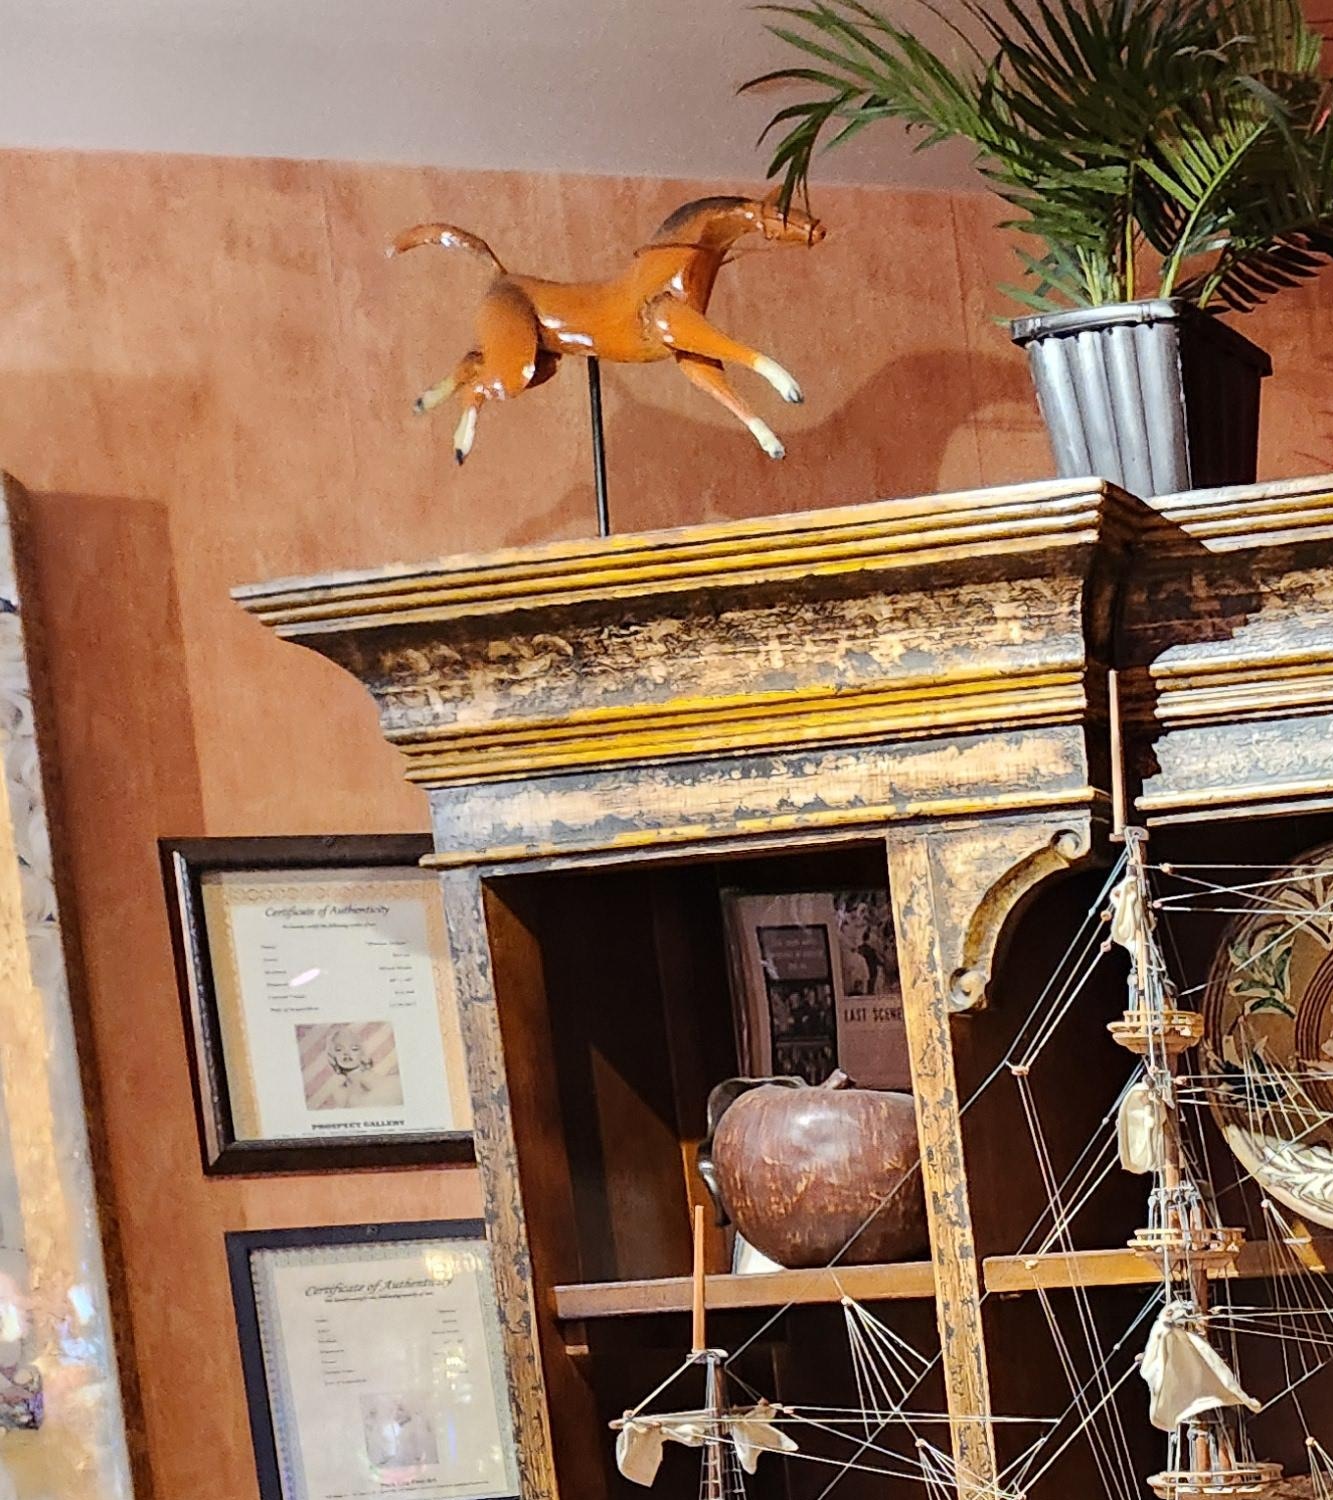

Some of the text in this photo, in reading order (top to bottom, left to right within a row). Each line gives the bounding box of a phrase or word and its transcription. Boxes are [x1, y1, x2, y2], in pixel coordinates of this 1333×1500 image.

[265, 906, 314, 919] Certificate
[318, 905, 328, 918] of
[844, 1008, 866, 1022] LAST
[305, 1282, 365, 1297] Certificate
[367, 1280, 381, 1293] of
